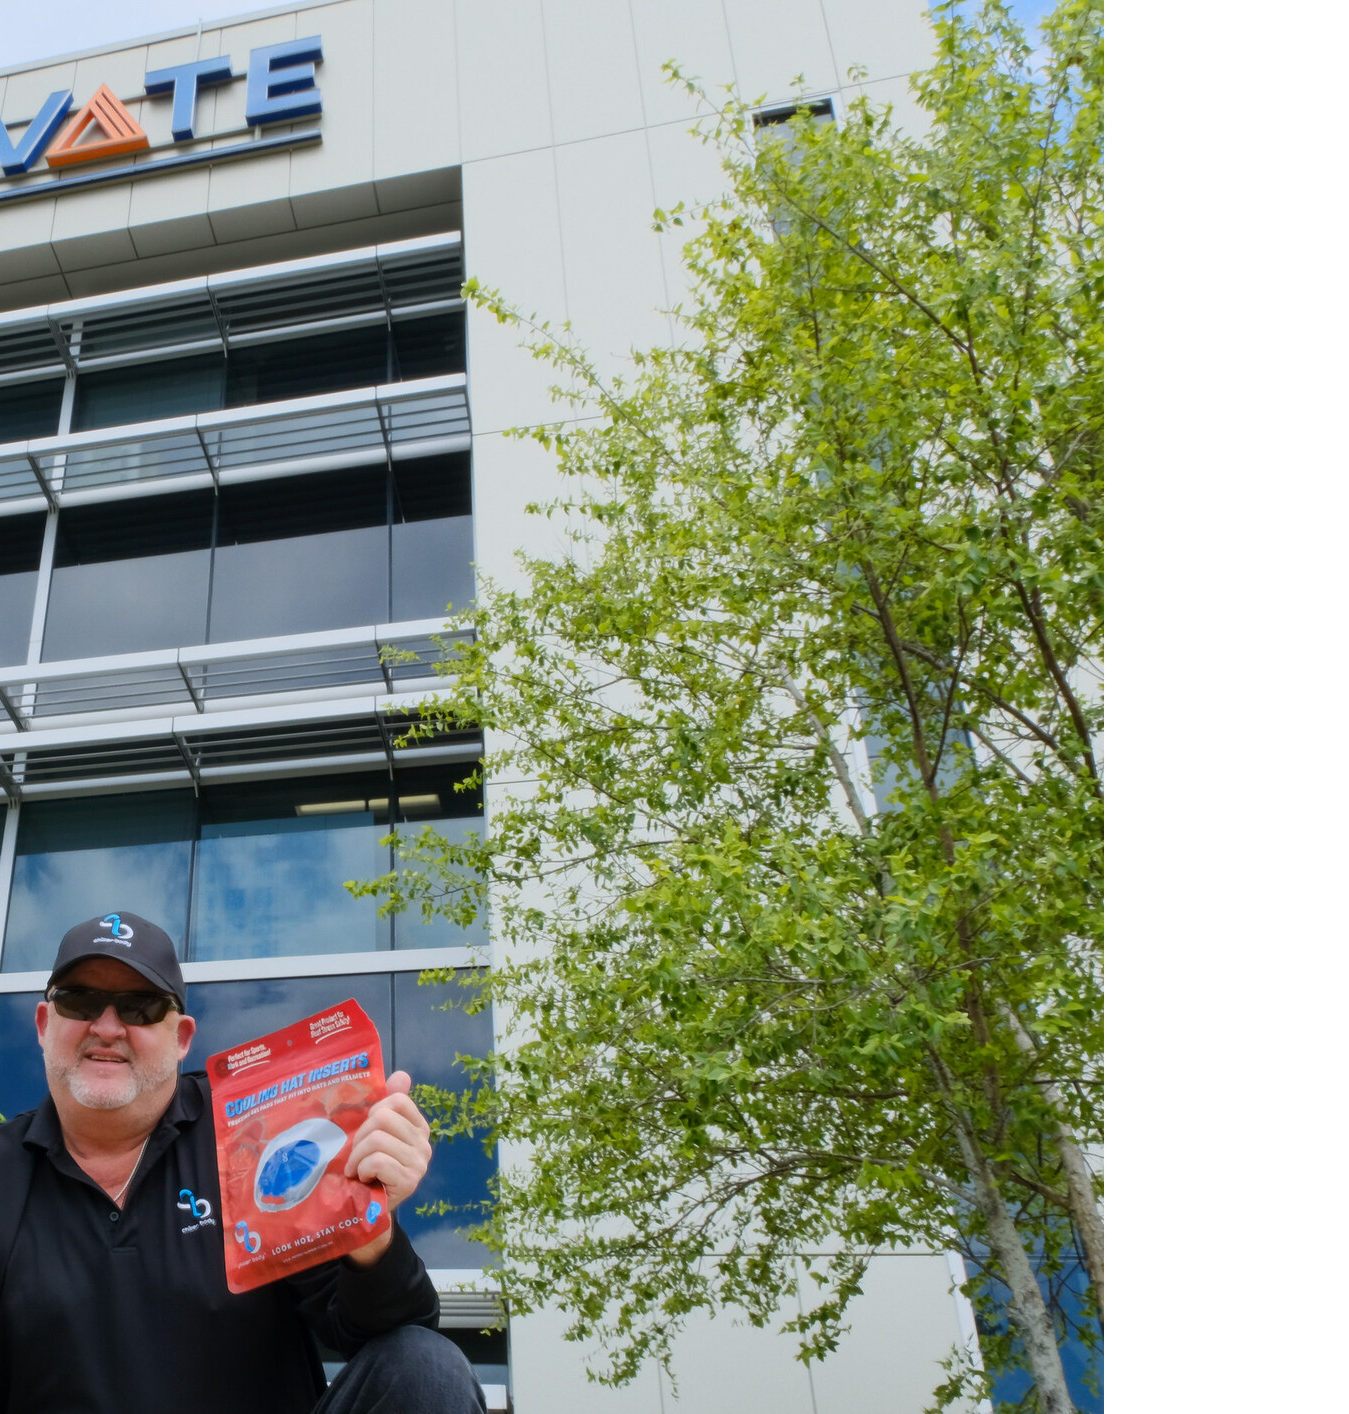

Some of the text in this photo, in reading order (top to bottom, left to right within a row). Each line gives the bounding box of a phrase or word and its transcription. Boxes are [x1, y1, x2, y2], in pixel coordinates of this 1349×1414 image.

[225, 1051, 370, 1118] COOLING HAT INSERTS
[273, 1095, 288, 1106] THAT
[288, 1091, 298, 1100] FIT
[297, 1086, 311, 1096] INTO
[311, 1081, 327, 1092] HATS
[327, 1076, 341, 1087] AND
[340, 1071, 371, 1083] HELMETS
[271, 1242, 293, 1256] LOOK
[294, 1234, 314, 1247] HOT,
[315, 1225, 336, 1239] STAY
